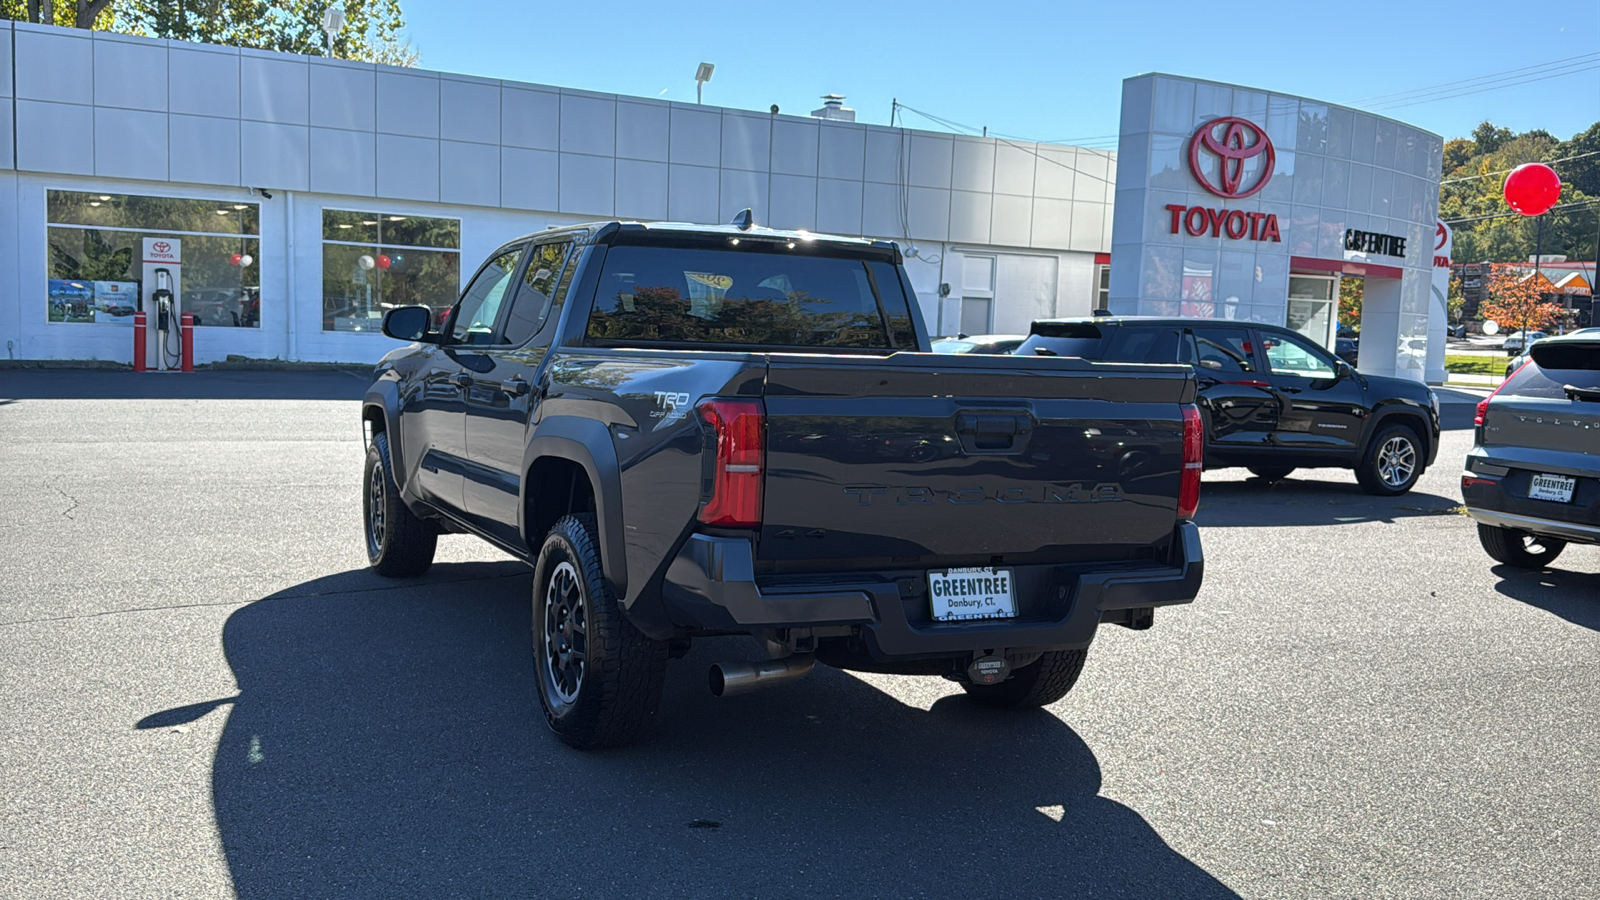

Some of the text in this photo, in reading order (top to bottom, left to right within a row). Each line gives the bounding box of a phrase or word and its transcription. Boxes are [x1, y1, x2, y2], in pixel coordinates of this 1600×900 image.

[1165, 204, 1281, 242] TOYOTA
[654, 391, 690, 410] TRD
[1520, 415, 1600, 428] VOLVO
[1533, 477, 1573, 491] GREENTREE
[844, 483, 1125, 506] TACOMA
[932, 577, 1008, 597] GREENTREE
[947, 597, 996, 609] Danbury, CT.
